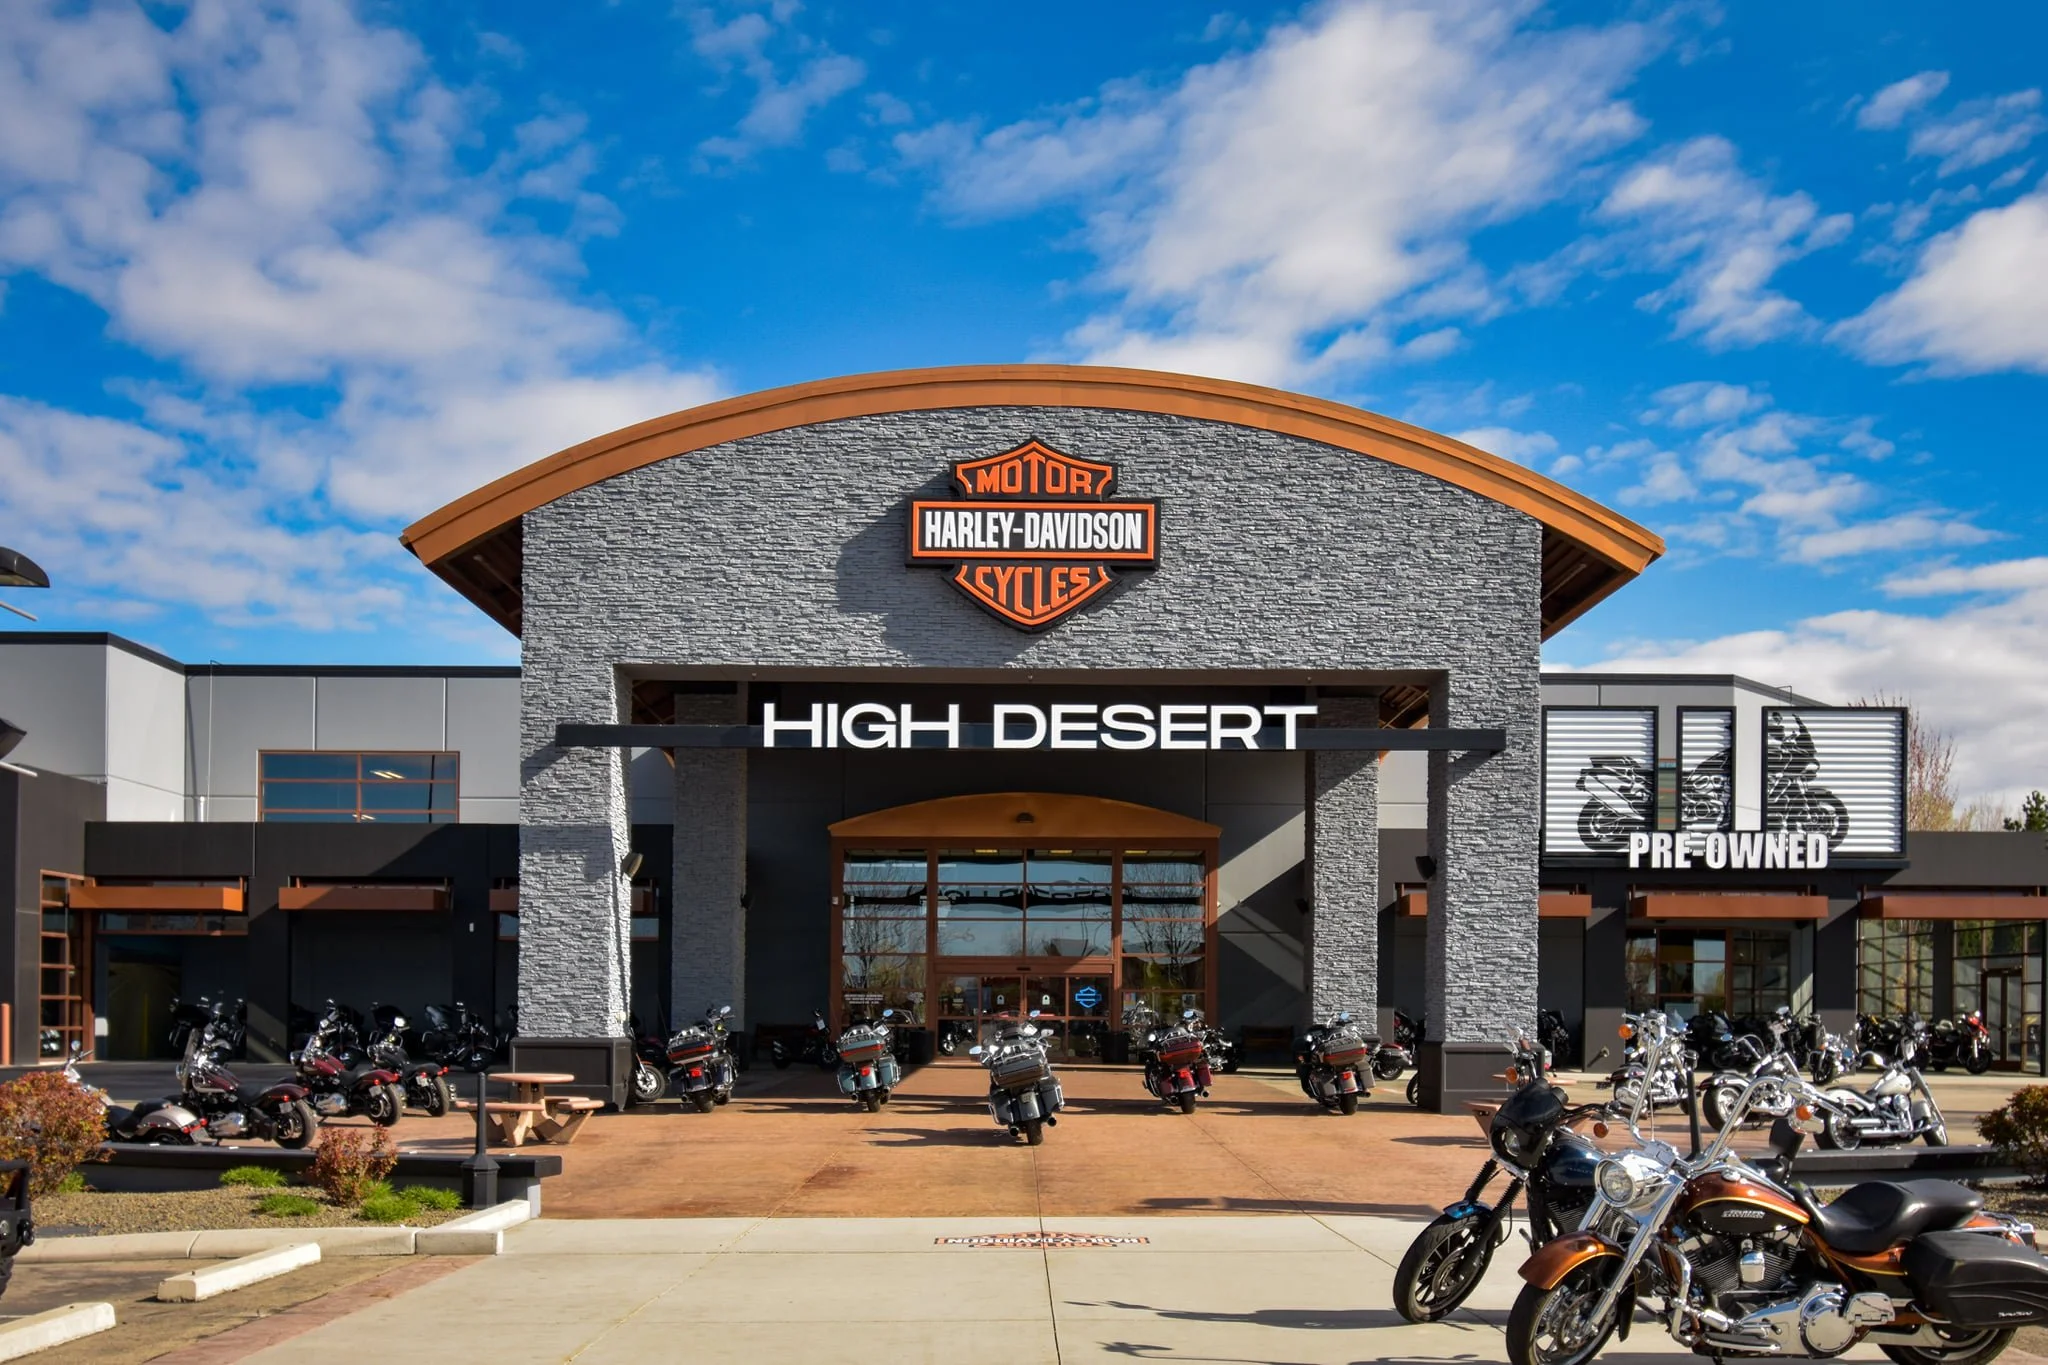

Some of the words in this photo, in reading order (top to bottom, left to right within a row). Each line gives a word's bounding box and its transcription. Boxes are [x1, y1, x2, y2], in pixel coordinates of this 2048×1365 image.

[976, 451, 1092, 495] MOTOR
[925, 510, 1142, 550] HARLEY-DAVIDSON
[975, 565, 1090, 617] CYCLES
[763, 702, 960, 749] HIGH
[992, 703, 1318, 750] DESERT
[1629, 831, 1829, 869] PRE-OWNED
